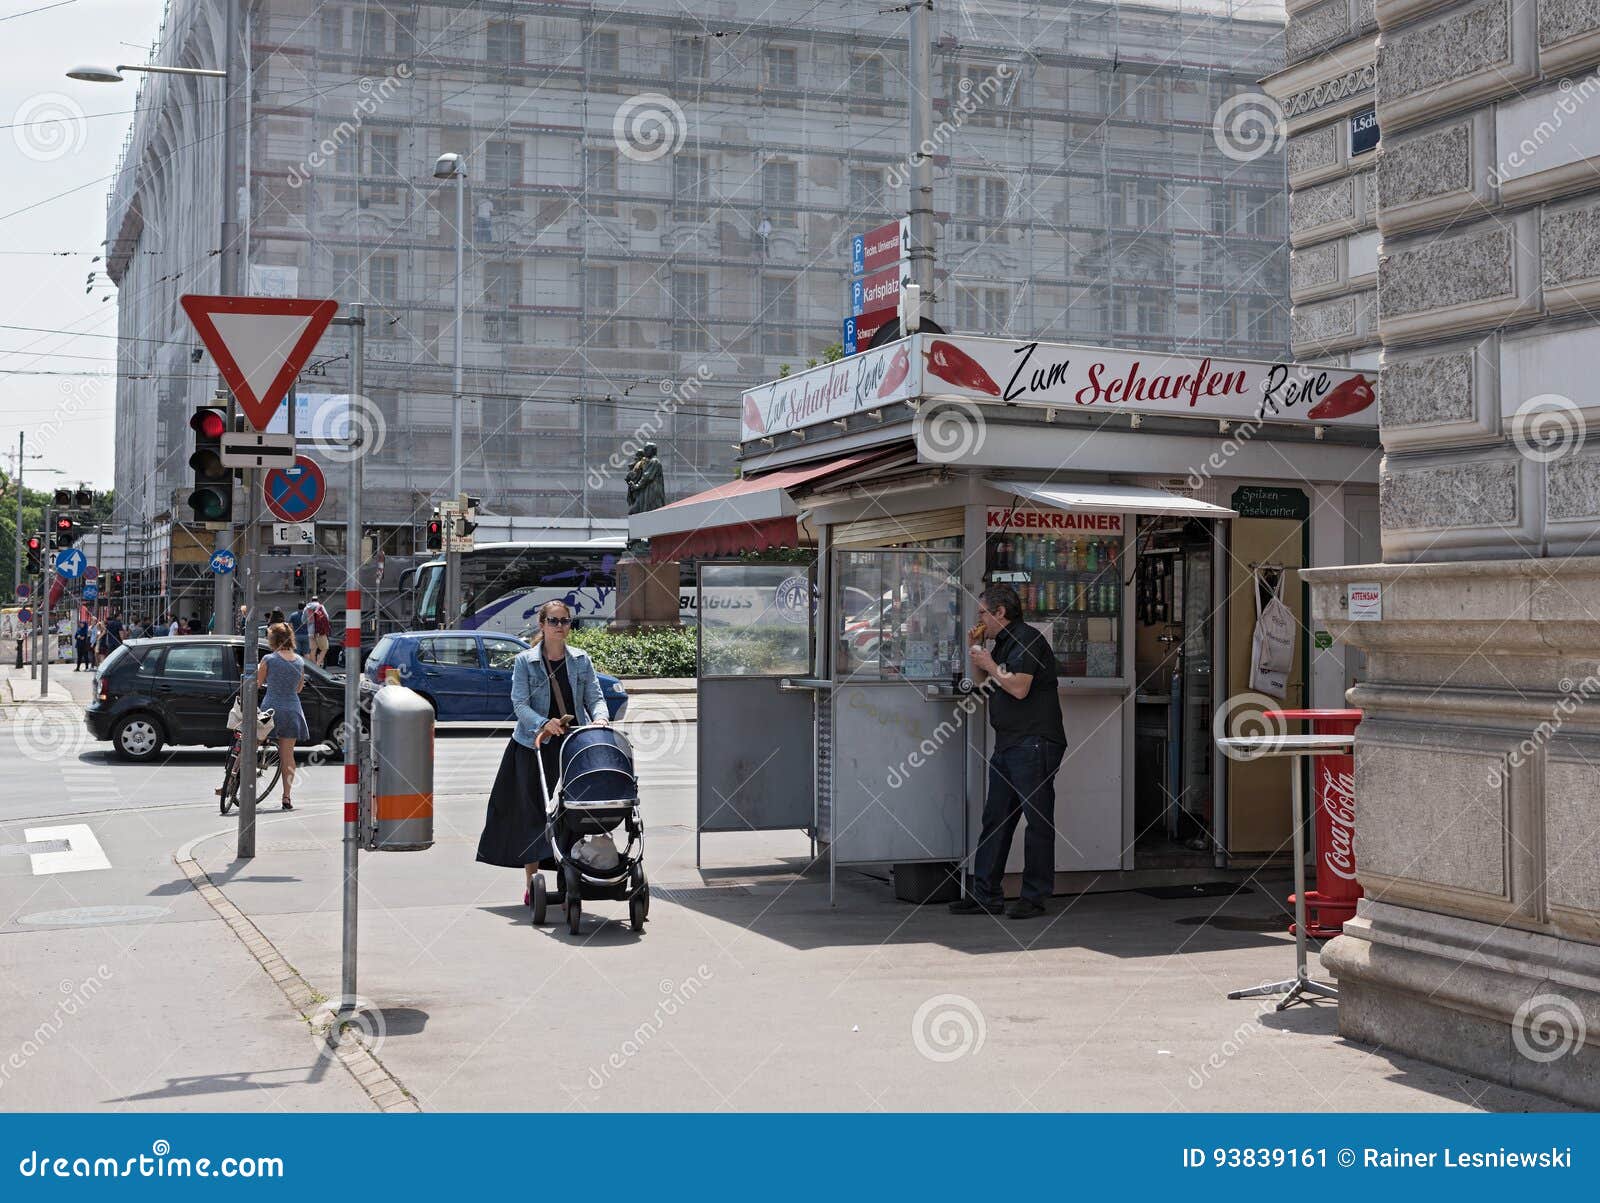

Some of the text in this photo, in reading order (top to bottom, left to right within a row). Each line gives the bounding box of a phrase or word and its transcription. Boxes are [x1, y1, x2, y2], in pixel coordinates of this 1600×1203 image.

[863, 279, 900, 303] Karlsplatz
[1003, 342, 1330, 418] Zum Scharfen Rene
[765, 353, 885, 433] Zum Scharfen Rene
[987, 509, 1121, 530] KÄSEKRAINER
[1351, 591, 1379, 601] ATTENSAM
